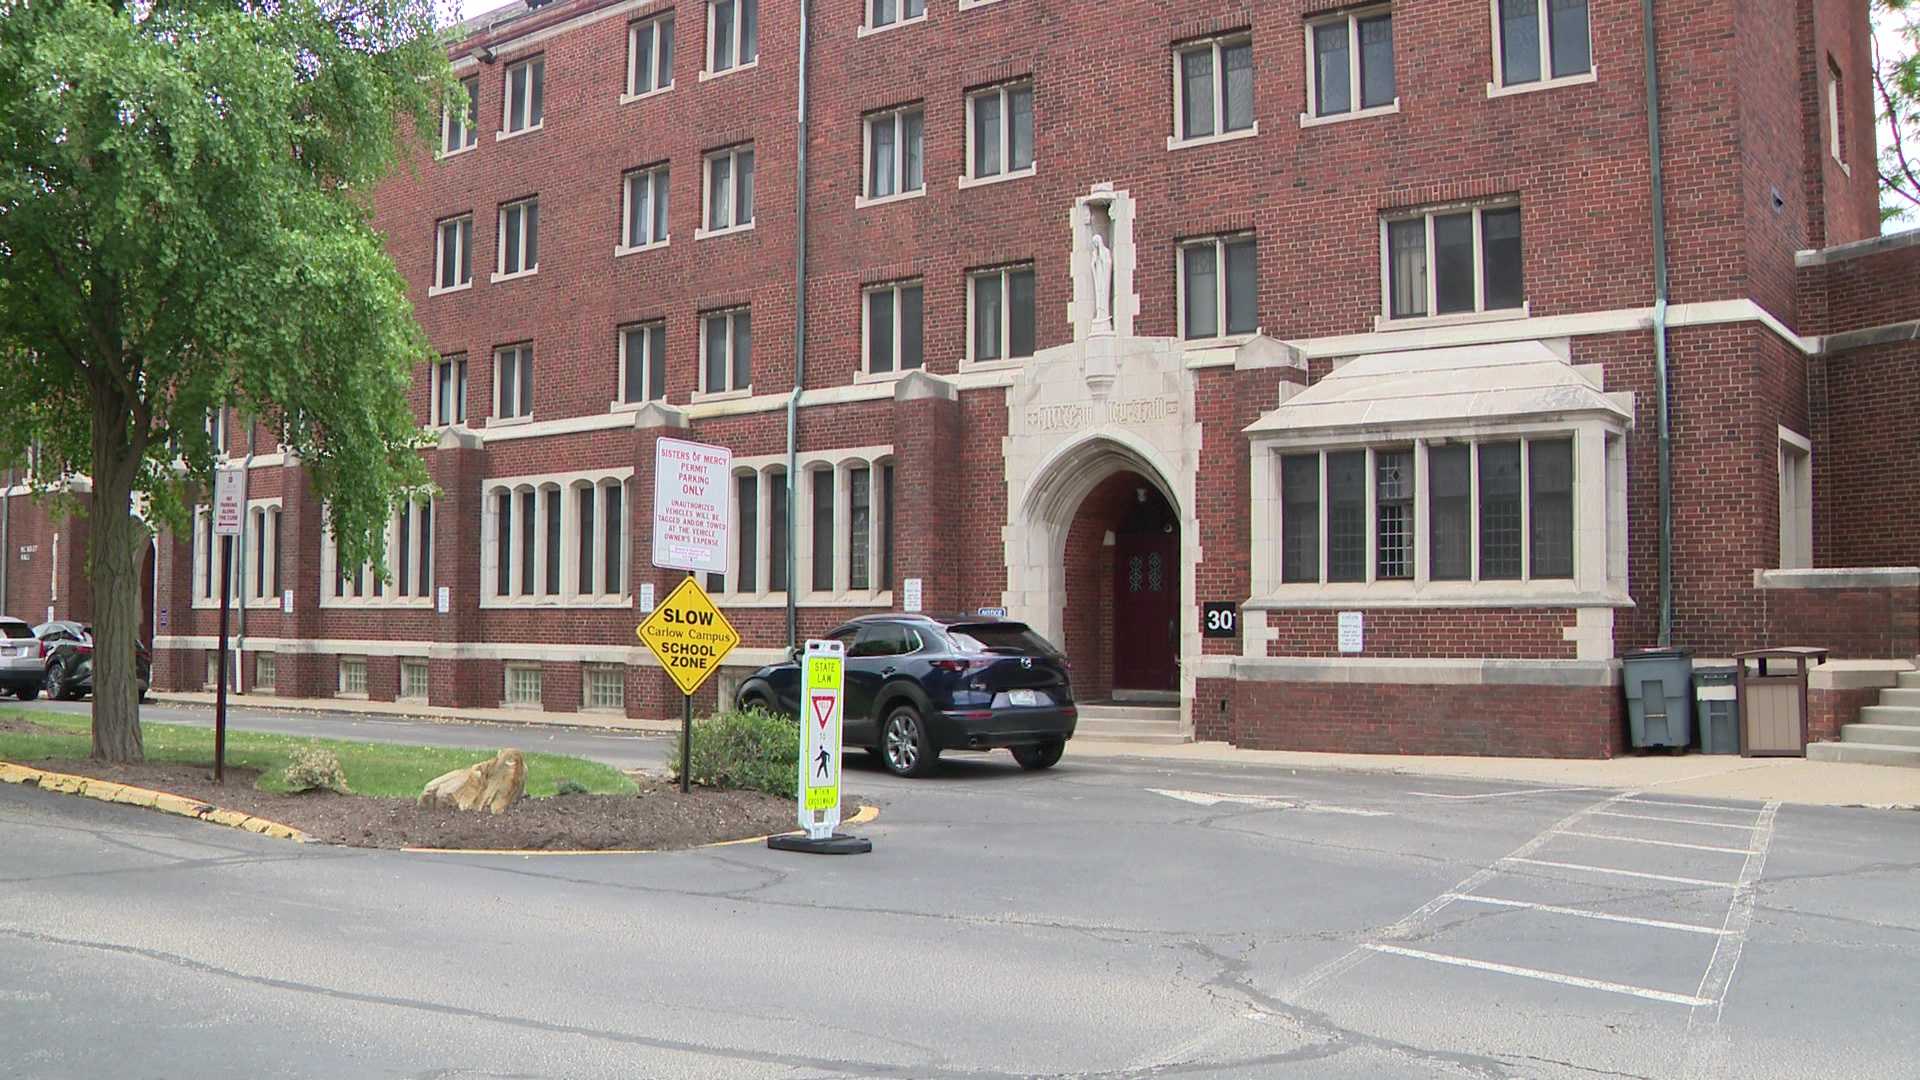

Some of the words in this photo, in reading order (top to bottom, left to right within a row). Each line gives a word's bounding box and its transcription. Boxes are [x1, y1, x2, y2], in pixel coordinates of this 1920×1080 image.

[661, 448, 689, 461] SISTERS
[692, 453, 702, 462] OF
[704, 456, 727, 466] MERCY
[681, 462, 708, 474] PERMIT
[678, 472, 710, 485] PARKING
[682, 484, 705, 496] ONLY
[666, 507, 693, 518] VEHICLES
[658, 514, 681, 525] TAGGED
[663, 608, 714, 626] SLOW
[1207, 610, 1233, 630] 30
[647, 625, 684, 639] Carlow
[688, 628, 730, 644] Campus
[661, 642, 716, 657] SCHOOL
[670, 655, 708, 669] ZONE
[814, 662, 836, 673] STATE
[817, 674, 832, 684] LAW
